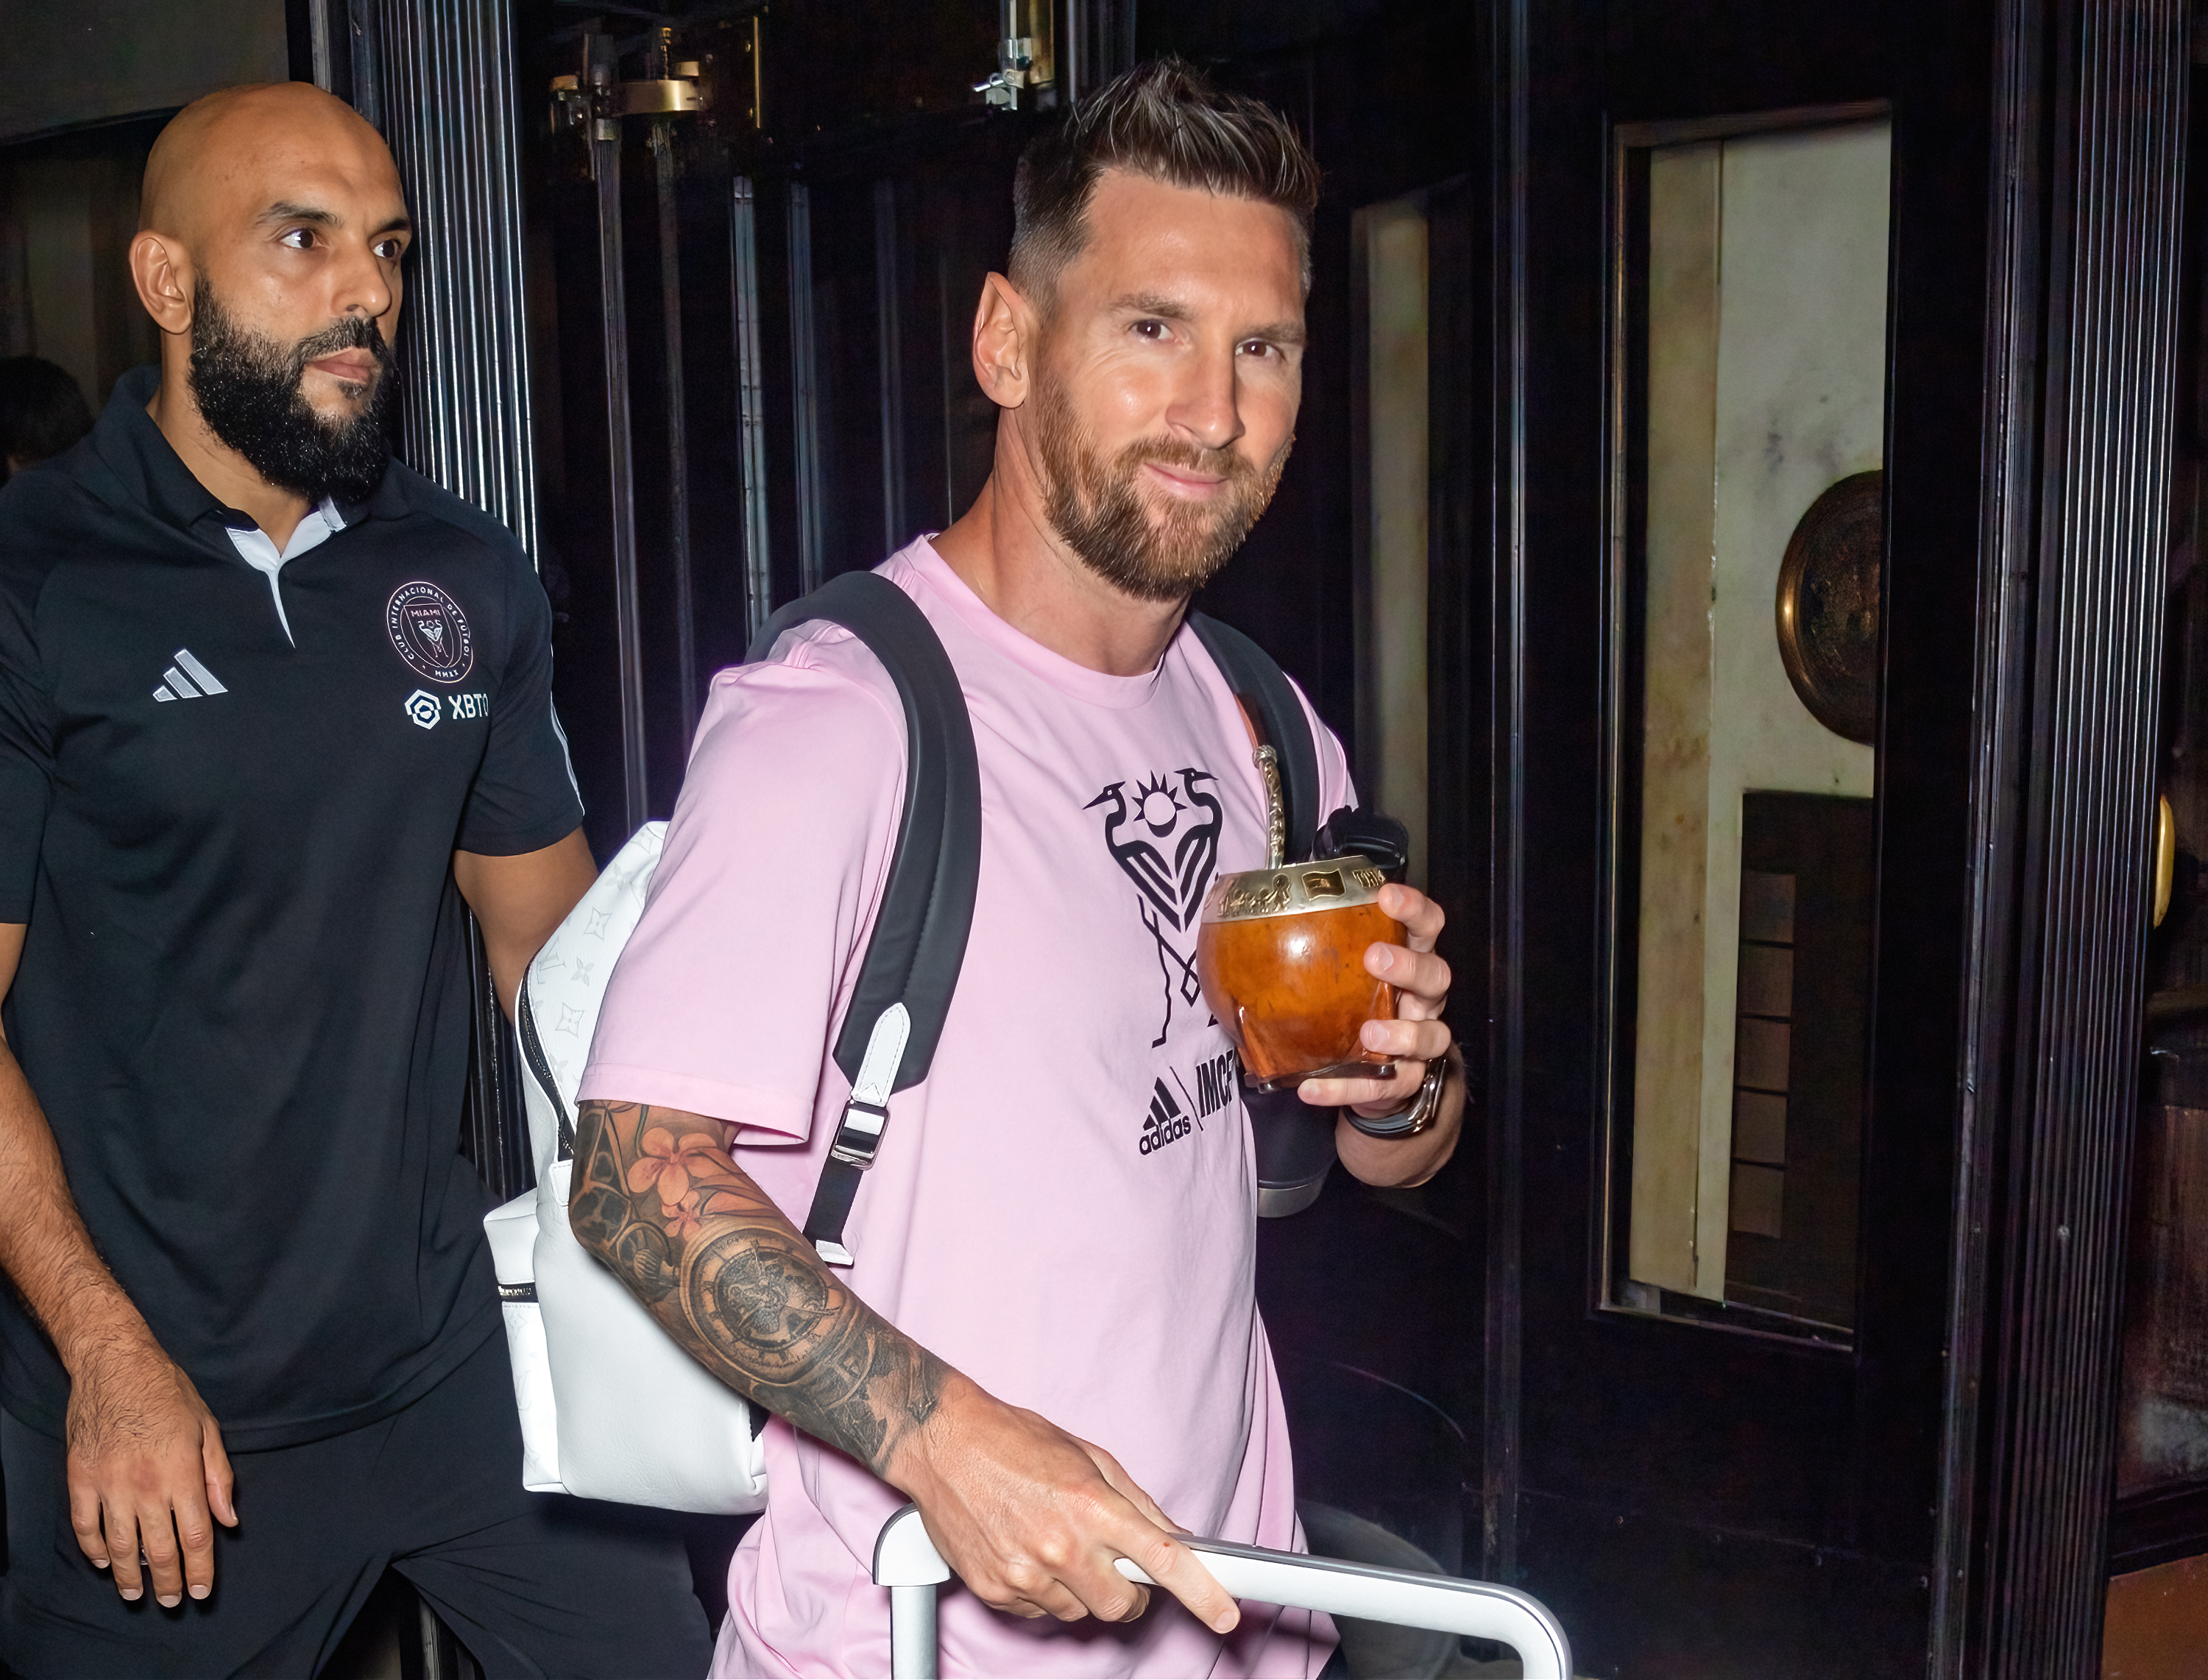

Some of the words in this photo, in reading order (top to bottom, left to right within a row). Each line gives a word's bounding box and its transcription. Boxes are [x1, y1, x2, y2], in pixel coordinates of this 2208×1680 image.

[394, 634, 414, 660] CLUB
[447, 603, 457, 616] DE
[411, 609, 441, 617] MIAMI
[1139, 1115, 1192, 1156] adidas
